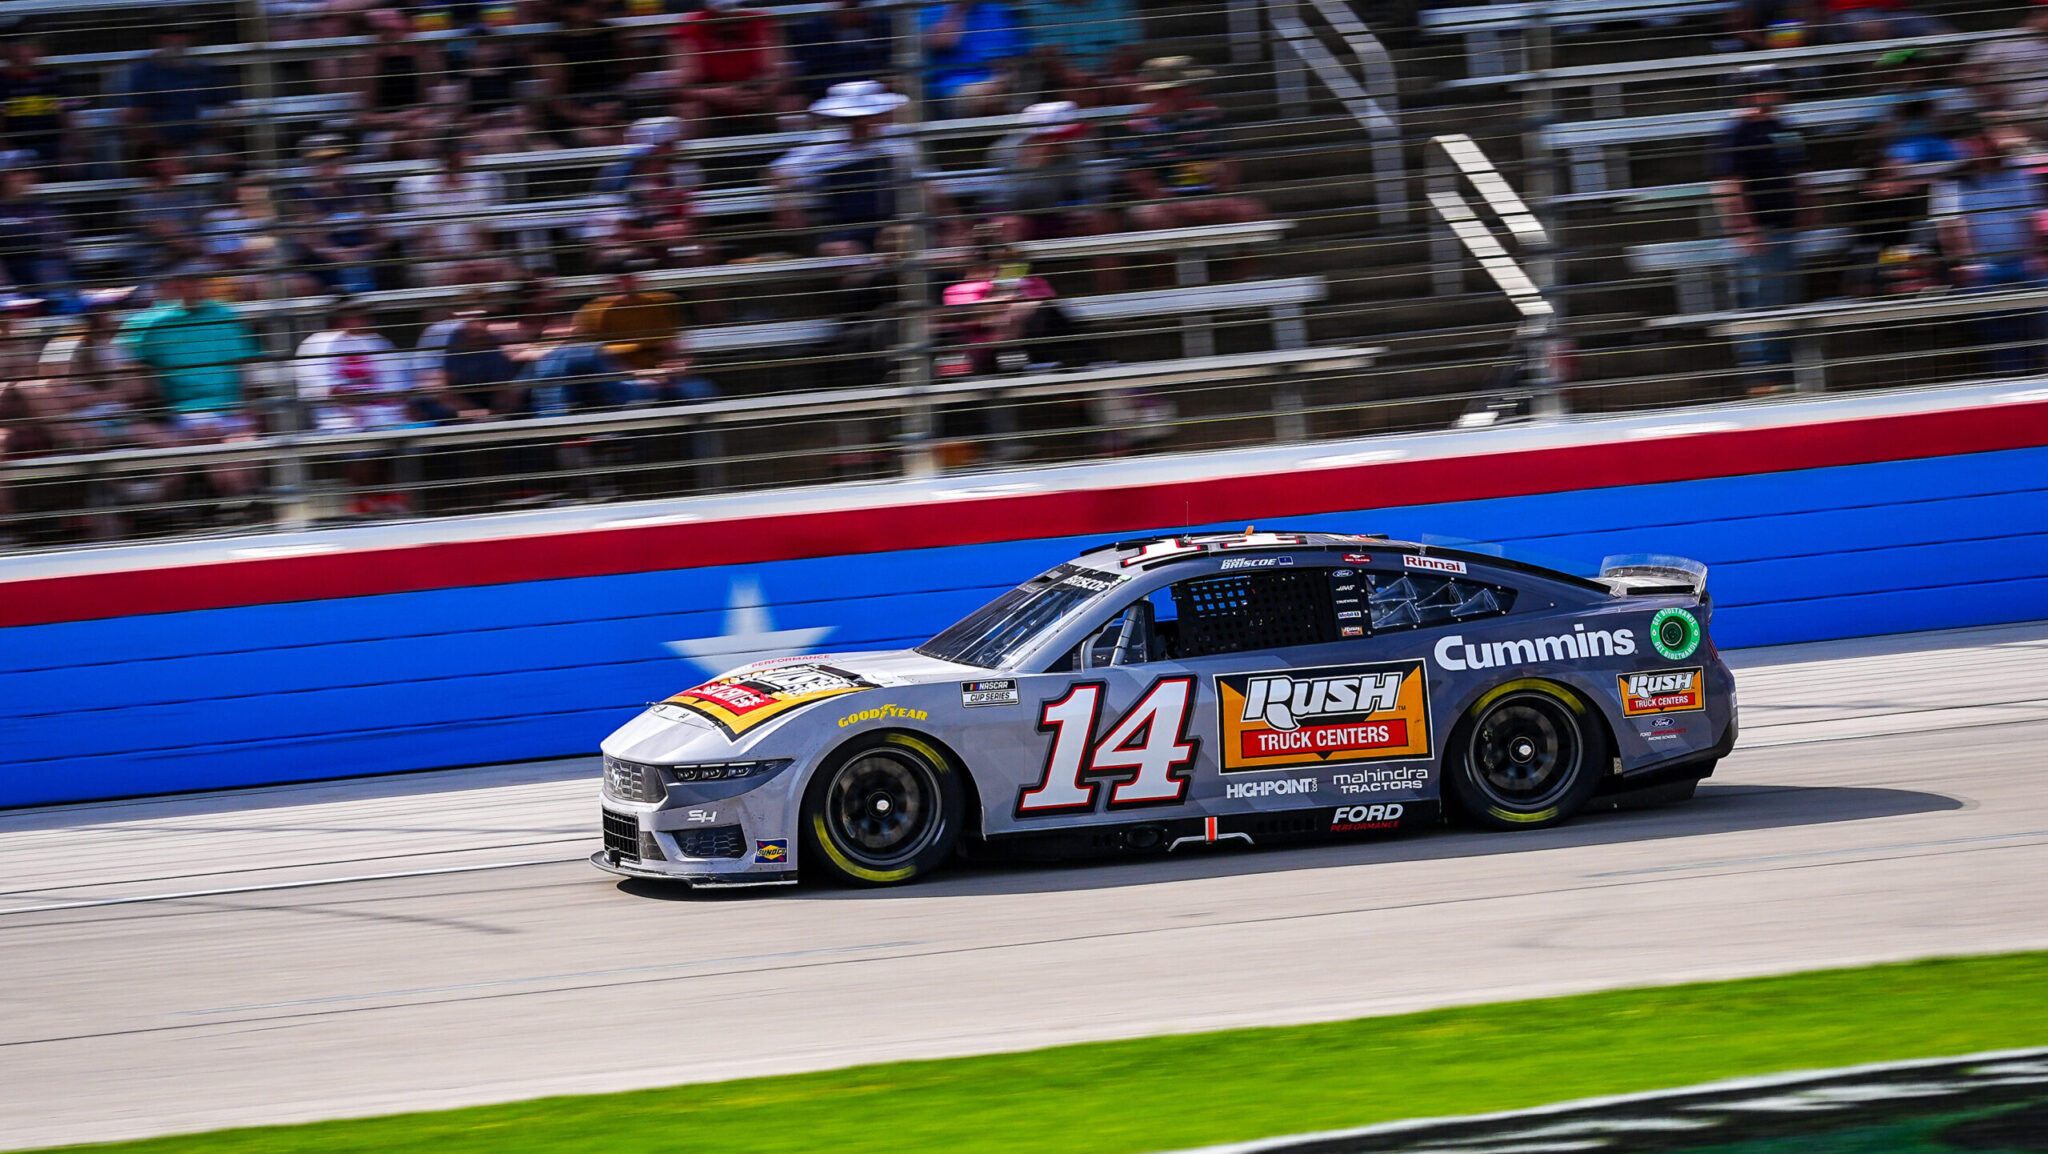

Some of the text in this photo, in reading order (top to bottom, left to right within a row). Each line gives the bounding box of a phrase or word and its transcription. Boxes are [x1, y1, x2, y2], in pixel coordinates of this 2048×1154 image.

[1220, 559, 1277, 570] BRISCOE
[1405, 556, 1462, 572] Rinnai
[1434, 623, 1636, 671] Cummins
[751, 655, 831, 668] PERFORMANCE
[979, 680, 1009, 690] NASCAR
[1628, 672, 1694, 699] RUSH
[970, 692, 1010, 702] CUP SERIES
[1241, 672, 1403, 731] RUSH
[1635, 696, 1689, 708] TRUCK CENTERS
[838, 704, 928, 728] GOODYEAR
[1015, 675, 1201, 817] 14
[1258, 725, 1390, 751] TRUCK CENTERS
[1333, 767, 1429, 785] mahindra
[1226, 778, 1312, 799] HIGHPOINT
[1341, 780, 1423, 794] TRACTORS
[1333, 803, 1404, 824] FORD
[1330, 820, 1400, 832] PERFORMANCE
[757, 847, 787, 857] SUNOCO
